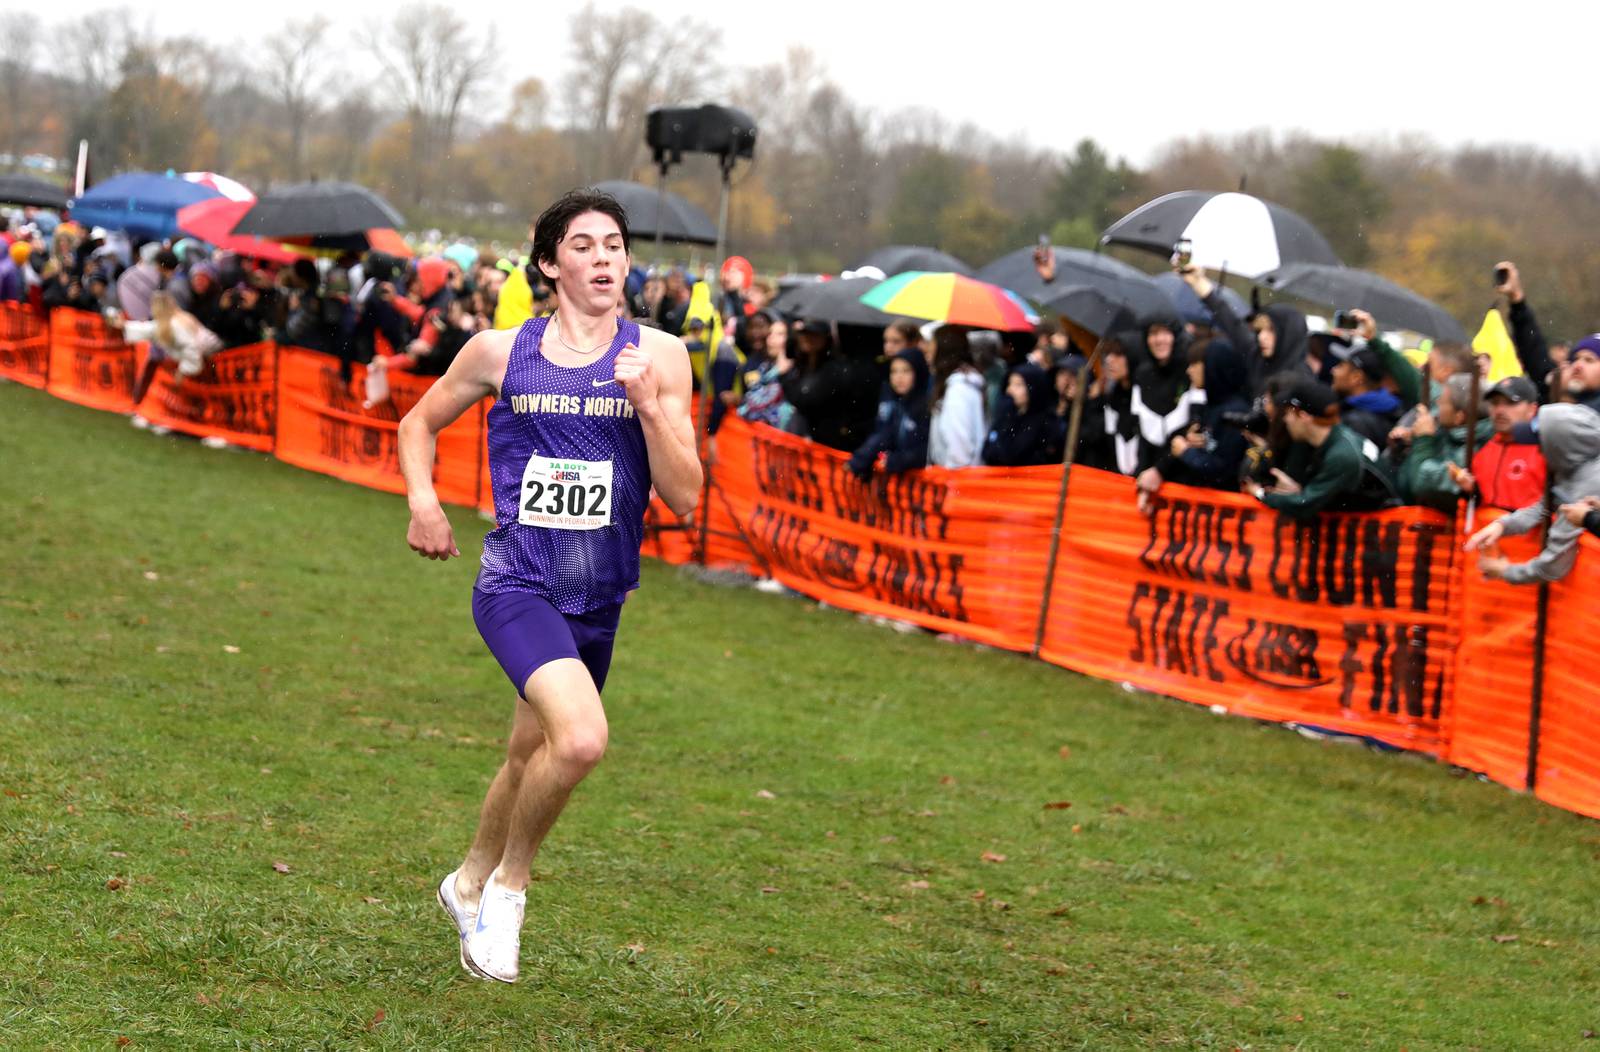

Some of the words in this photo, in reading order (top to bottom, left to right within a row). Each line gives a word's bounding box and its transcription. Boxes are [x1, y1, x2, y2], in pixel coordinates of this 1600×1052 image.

[511, 394, 581, 414] DOWNERS
[584, 396, 634, 418] NORTH
[549, 462, 561, 470] 3A
[563, 463, 588, 471] BOYS
[524, 480, 607, 517] 2302
[528, 514, 556, 524] RUNNING
[556, 516, 564, 524] IN
[564, 517, 586, 525] PEORIA
[1139, 496, 1256, 591] CROSS
[1128, 581, 1230, 683] STATE
